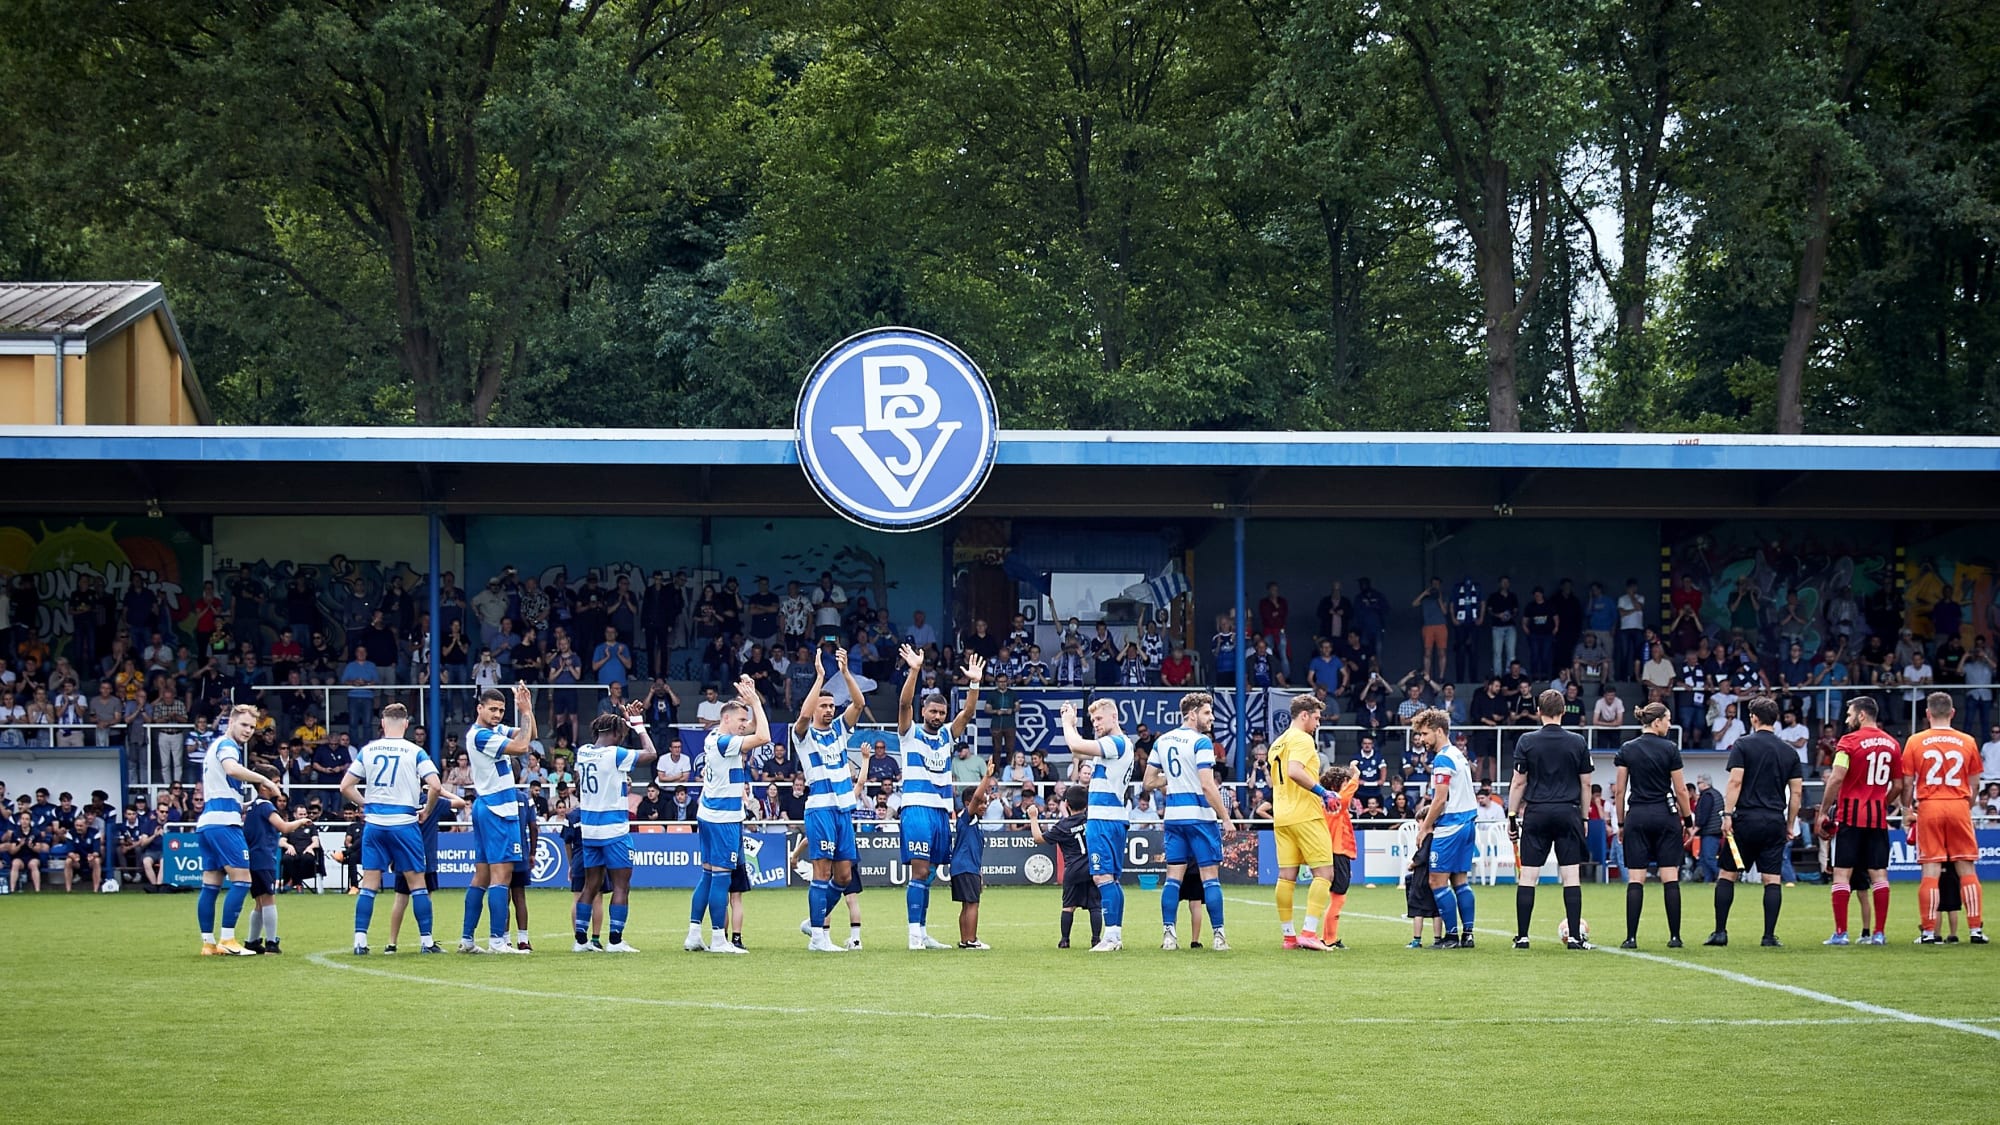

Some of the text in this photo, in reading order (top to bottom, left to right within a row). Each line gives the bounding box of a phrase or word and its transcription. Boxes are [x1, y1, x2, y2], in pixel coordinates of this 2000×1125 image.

[1118, 699, 1183, 726] SV-Fan
[1922, 735, 1964, 747] CONCORDIA
[372, 754, 401, 788] 27
[1167, 746, 1182, 778] 6
[1866, 751, 1892, 786] 16
[1922, 749, 1965, 787] 22
[577, 762, 599, 795] 26
[908, 841, 929, 853] BAB
[989, 837, 1009, 848] BEI
[1011, 837, 1038, 848] UNS.
[436, 850, 467, 860] NICHT
[632, 851, 689, 866] MITGLIED
[749, 867, 785, 886] KLUB
[861, 866, 887, 876] BRAU
